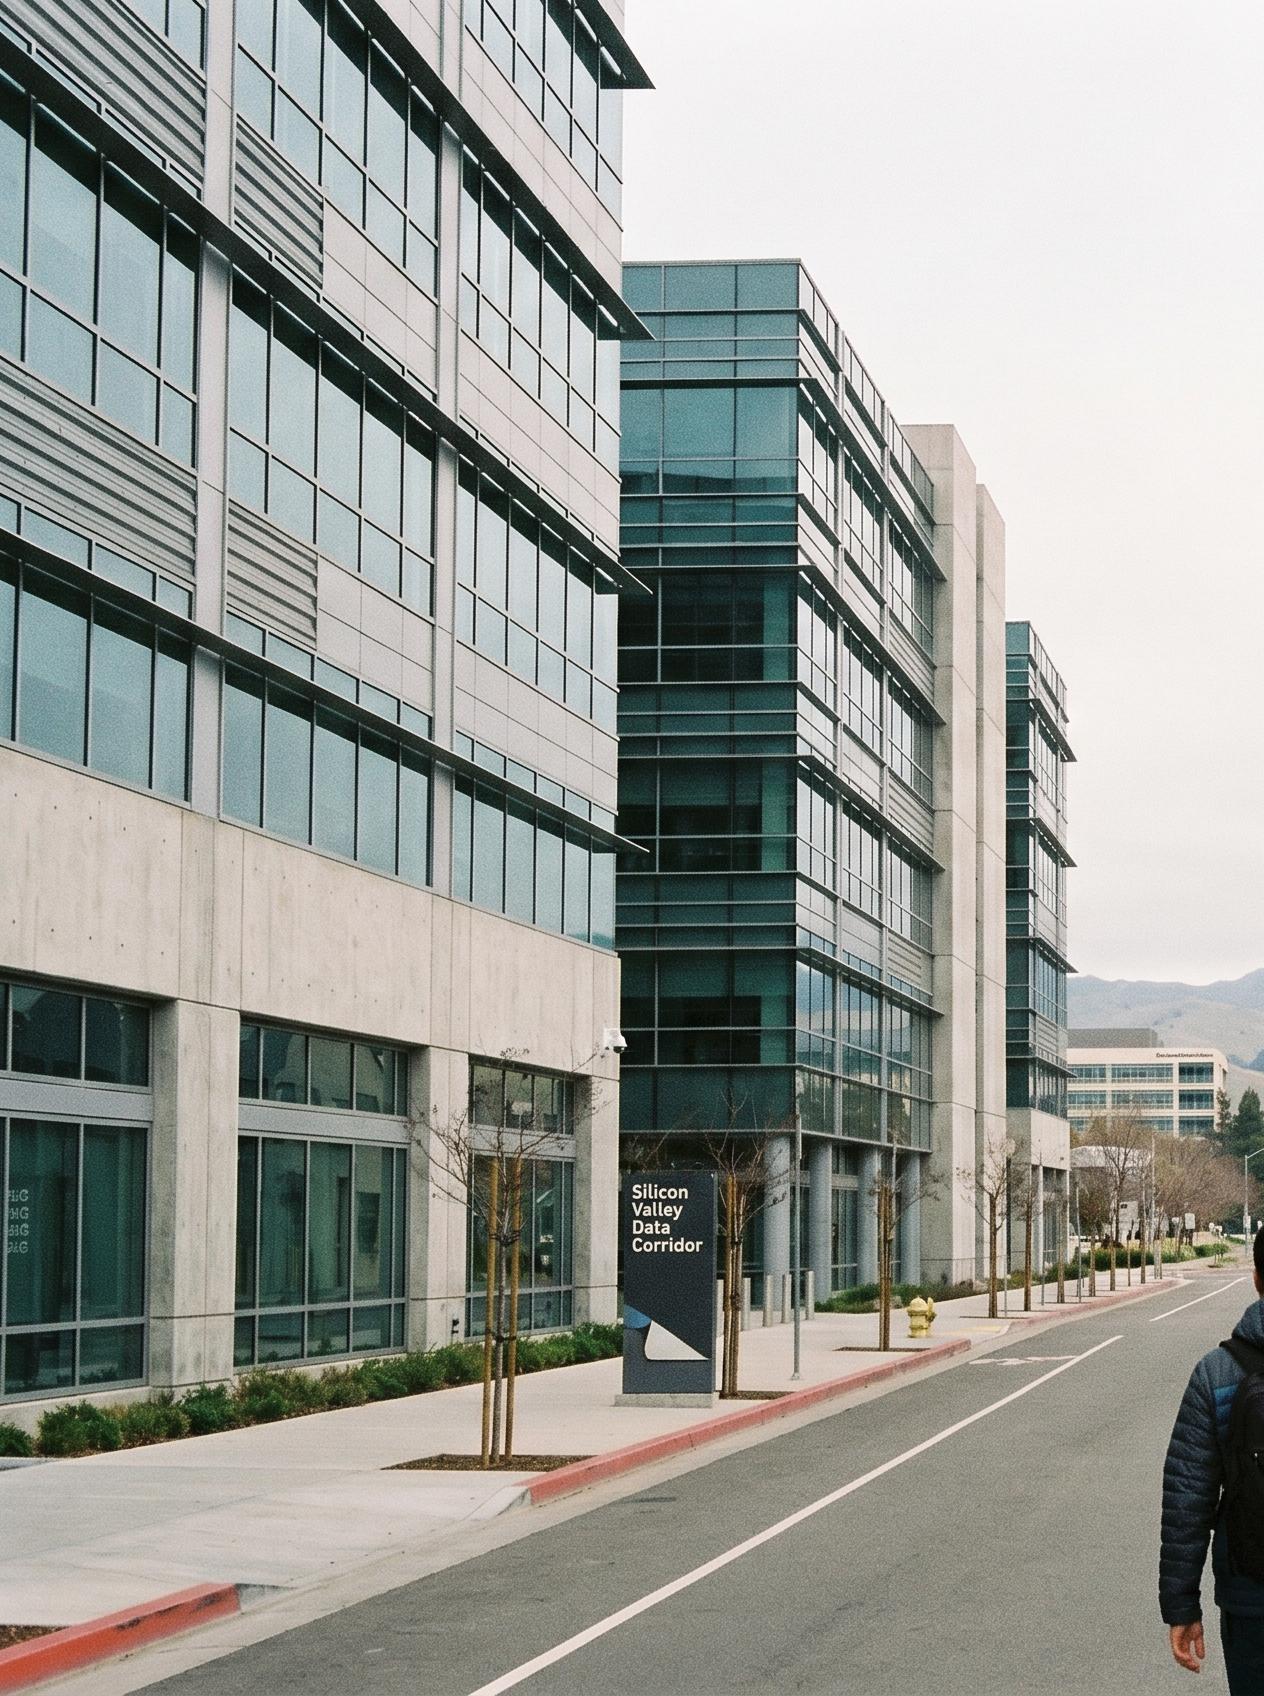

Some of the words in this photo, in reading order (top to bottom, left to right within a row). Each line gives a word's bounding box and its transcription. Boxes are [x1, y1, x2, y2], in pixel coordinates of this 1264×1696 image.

[632, 1183, 688, 1199] Silicon
[632, 1202, 683, 1221] Valley
[632, 1220, 670, 1235] Data
[632, 1237, 703, 1253] Corridor
